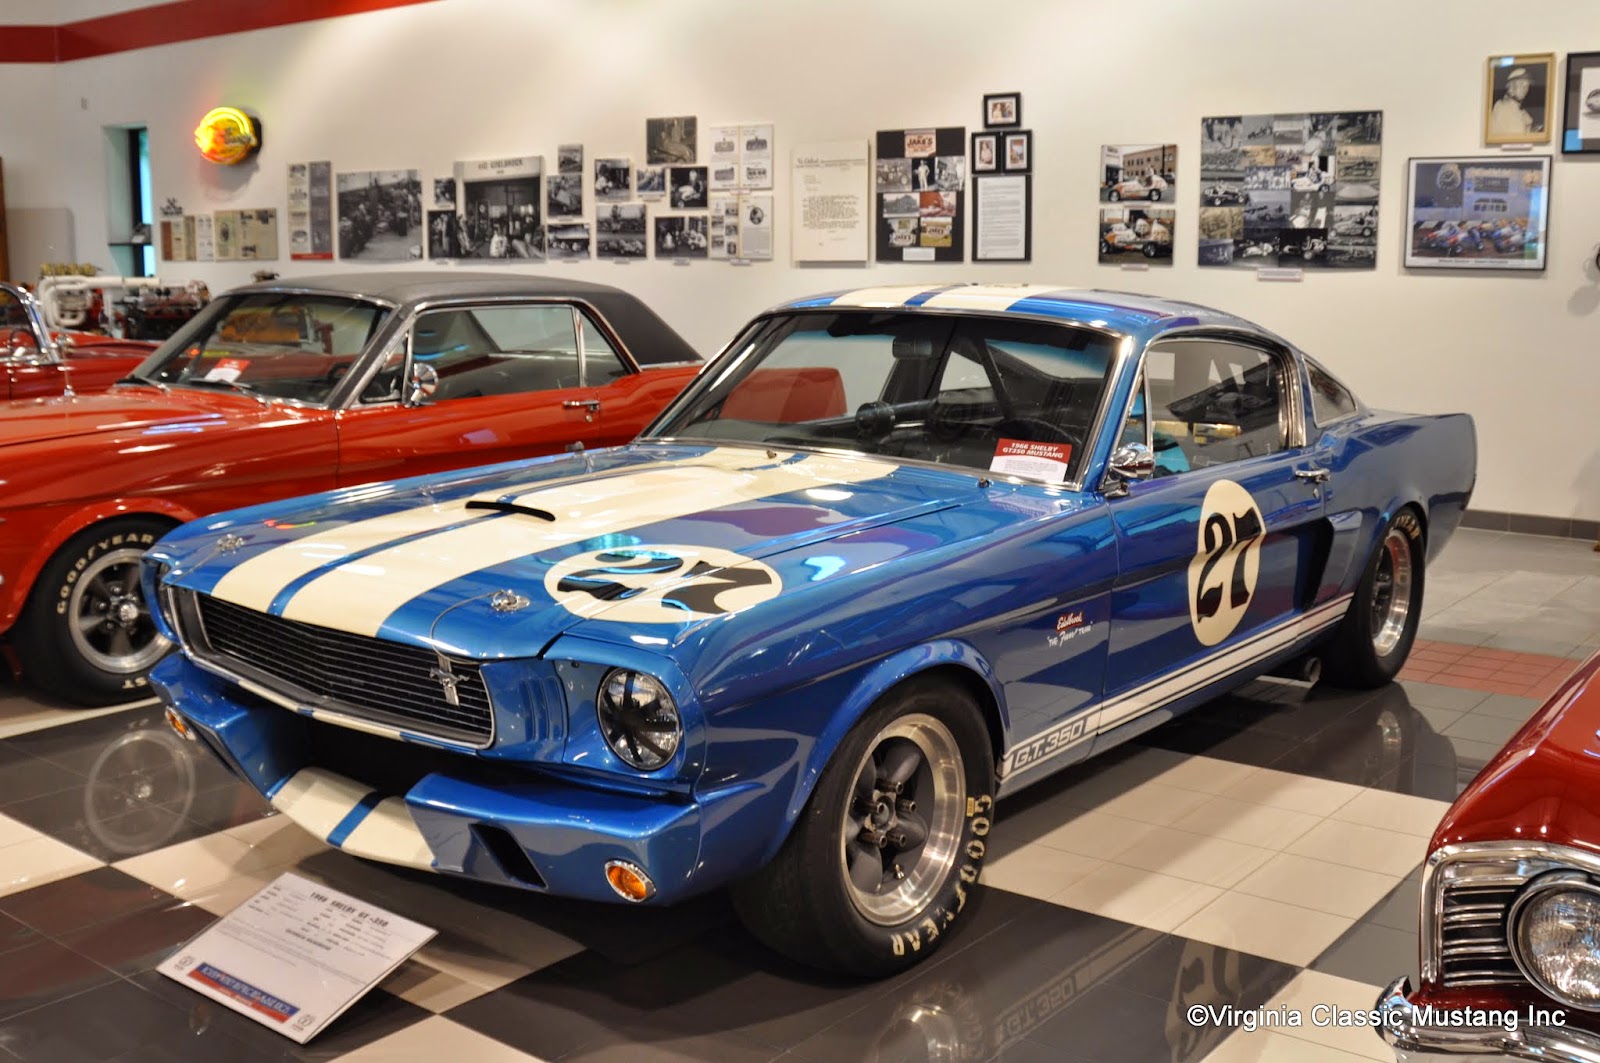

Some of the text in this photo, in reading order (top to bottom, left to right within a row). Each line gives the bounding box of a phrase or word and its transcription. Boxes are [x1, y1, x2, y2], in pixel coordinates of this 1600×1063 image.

[1002, 447, 1064, 459] GT350 MUSTANG
[1011, 442, 1059, 452] 1966 SHELBY
[57, 533, 154, 615] GOODYEAR
[557, 550, 772, 615] 27
[1196, 507, 1262, 624] 27
